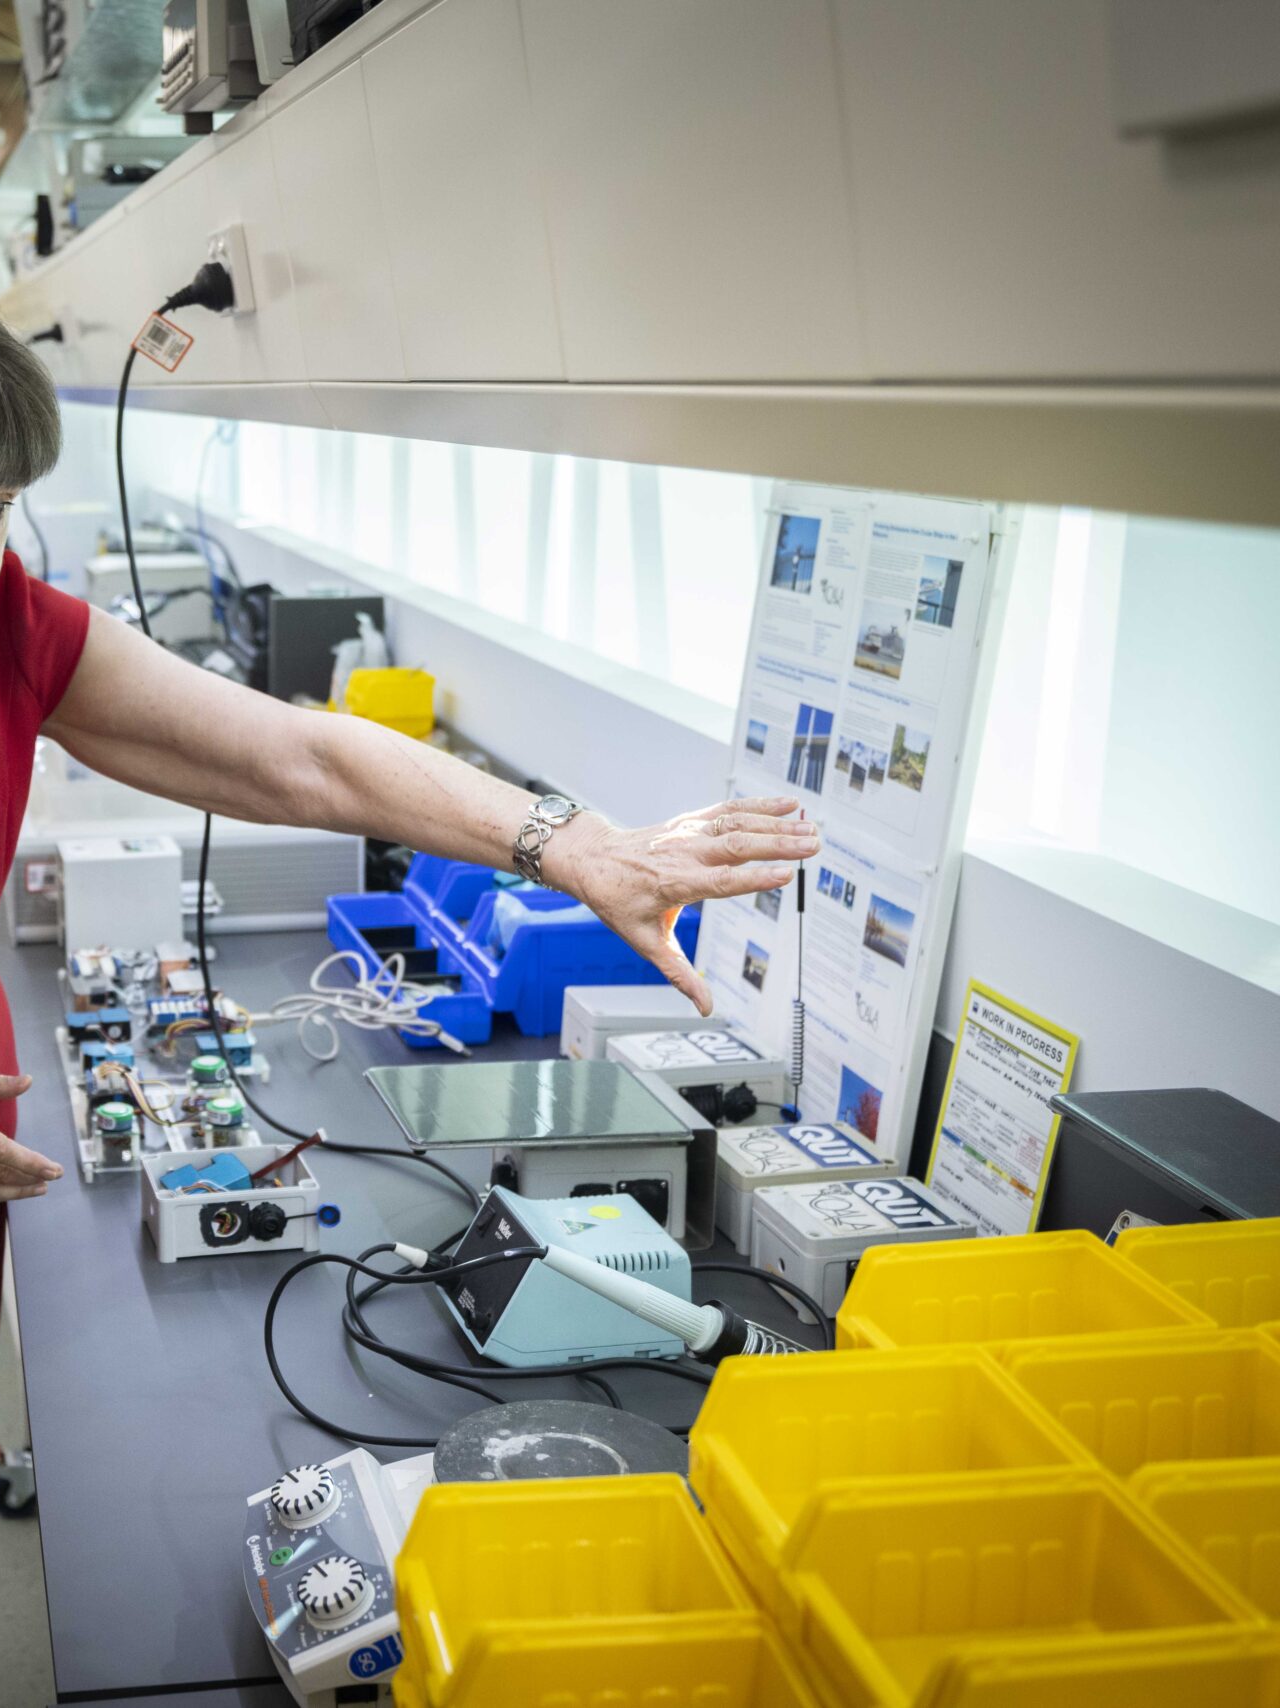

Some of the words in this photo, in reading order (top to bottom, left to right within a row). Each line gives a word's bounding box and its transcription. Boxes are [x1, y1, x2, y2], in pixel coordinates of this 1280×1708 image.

[687, 1031, 759, 1062] QUT
[982, 1007, 1005, 1028] WORK
[1006, 1021, 1014, 1035] IN
[1016, 1027, 1063, 1063] PROGRESS
[788, 1125, 872, 1165] QUT
[853, 1181, 946, 1226] QUT
[251, 1543, 266, 1577] Heidolph
